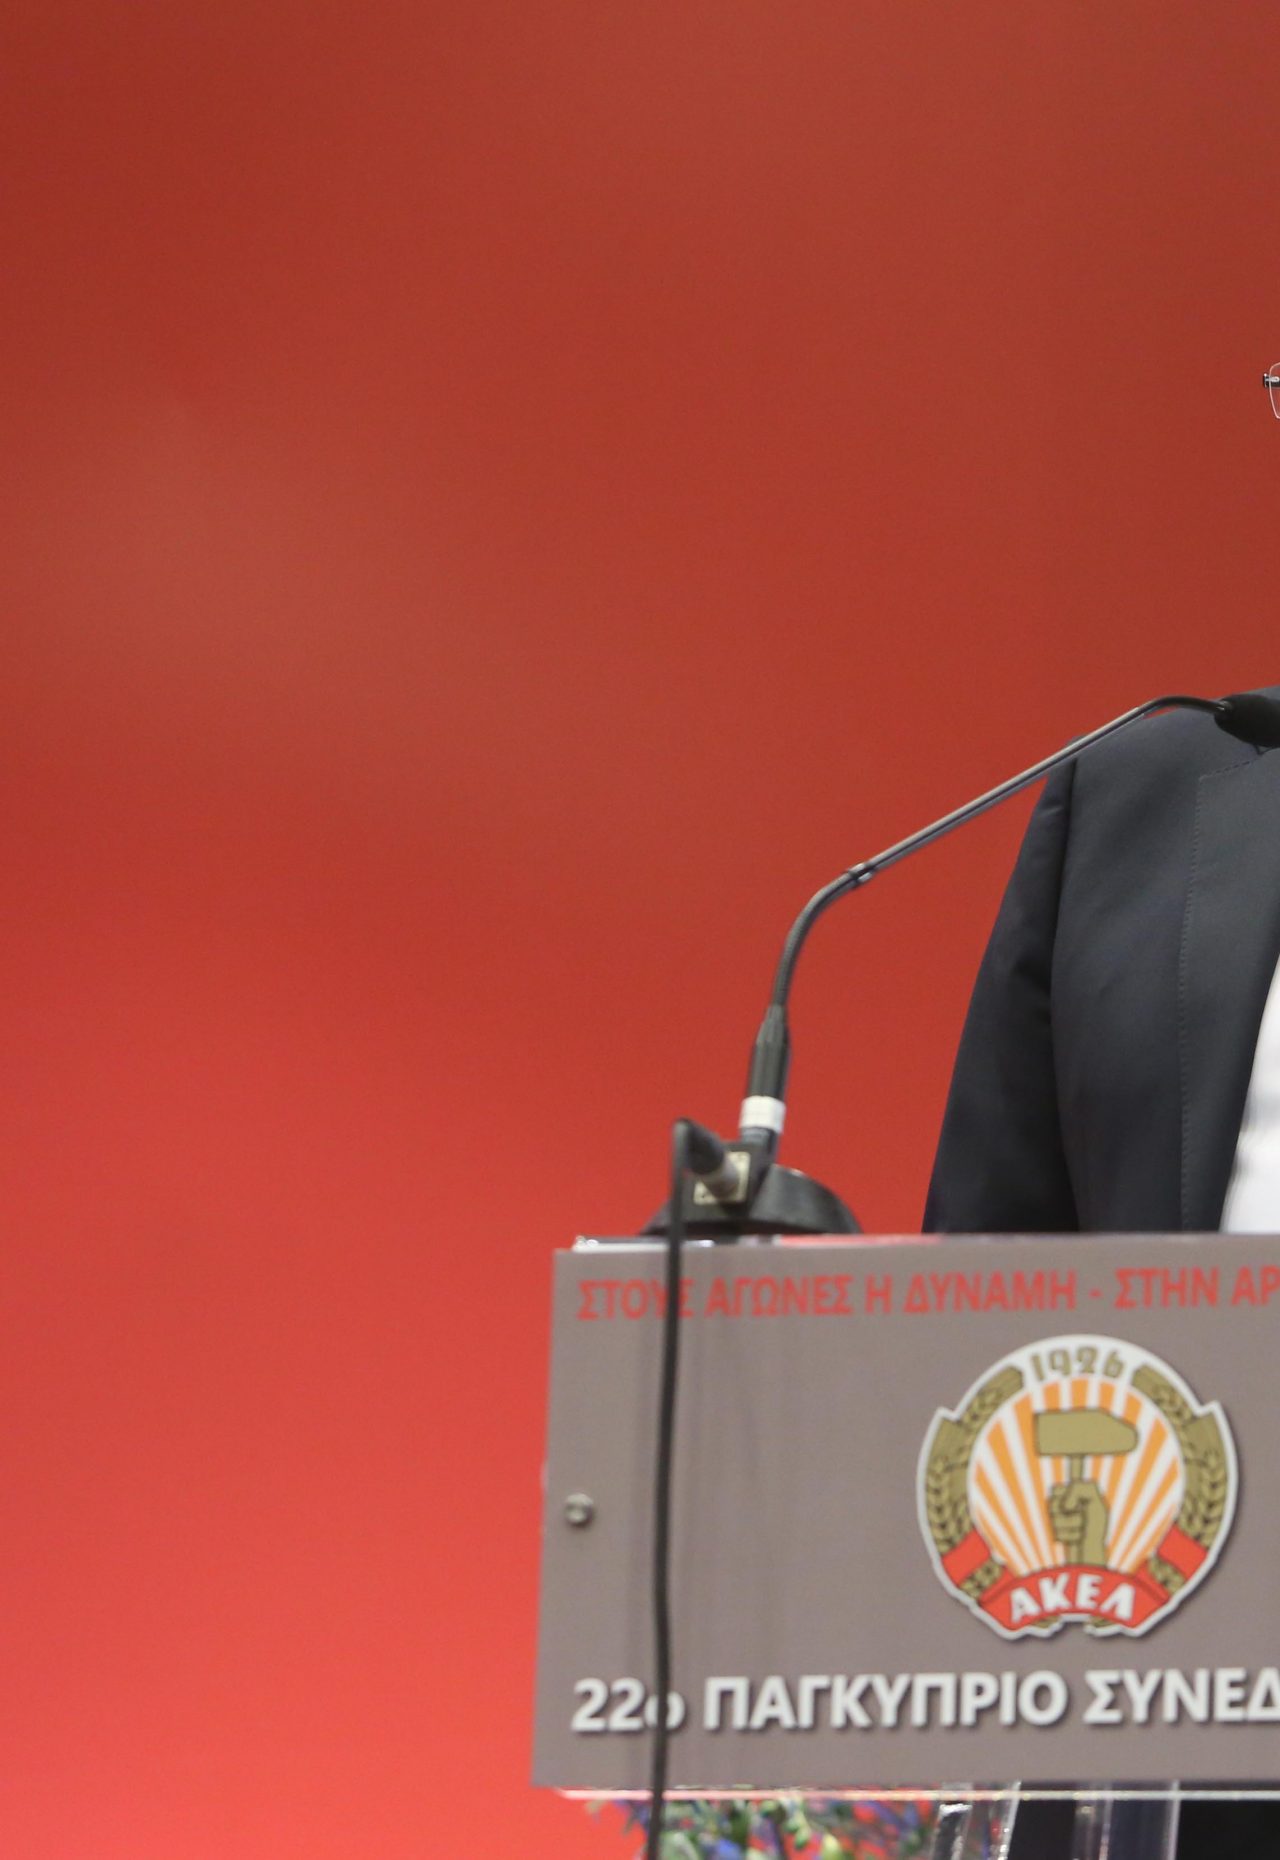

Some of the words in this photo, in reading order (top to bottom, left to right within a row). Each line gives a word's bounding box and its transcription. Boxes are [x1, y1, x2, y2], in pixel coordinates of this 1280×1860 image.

[704, 1273, 855, 1318] ΑΓΩΝΕΣ
[864, 1273, 894, 1314] Η
[902, 1269, 1078, 1315] ΔΥΝΑΜΗ
[1113, 1266, 1221, 1310] ΣΤΗΝ
[1031, 1345, 1125, 1383] 1926
[1010, 1572, 1136, 1624] ΑΚΕΛ
[704, 1671, 1067, 1730] ΠΑΓΚΥΠΡΙΟ
